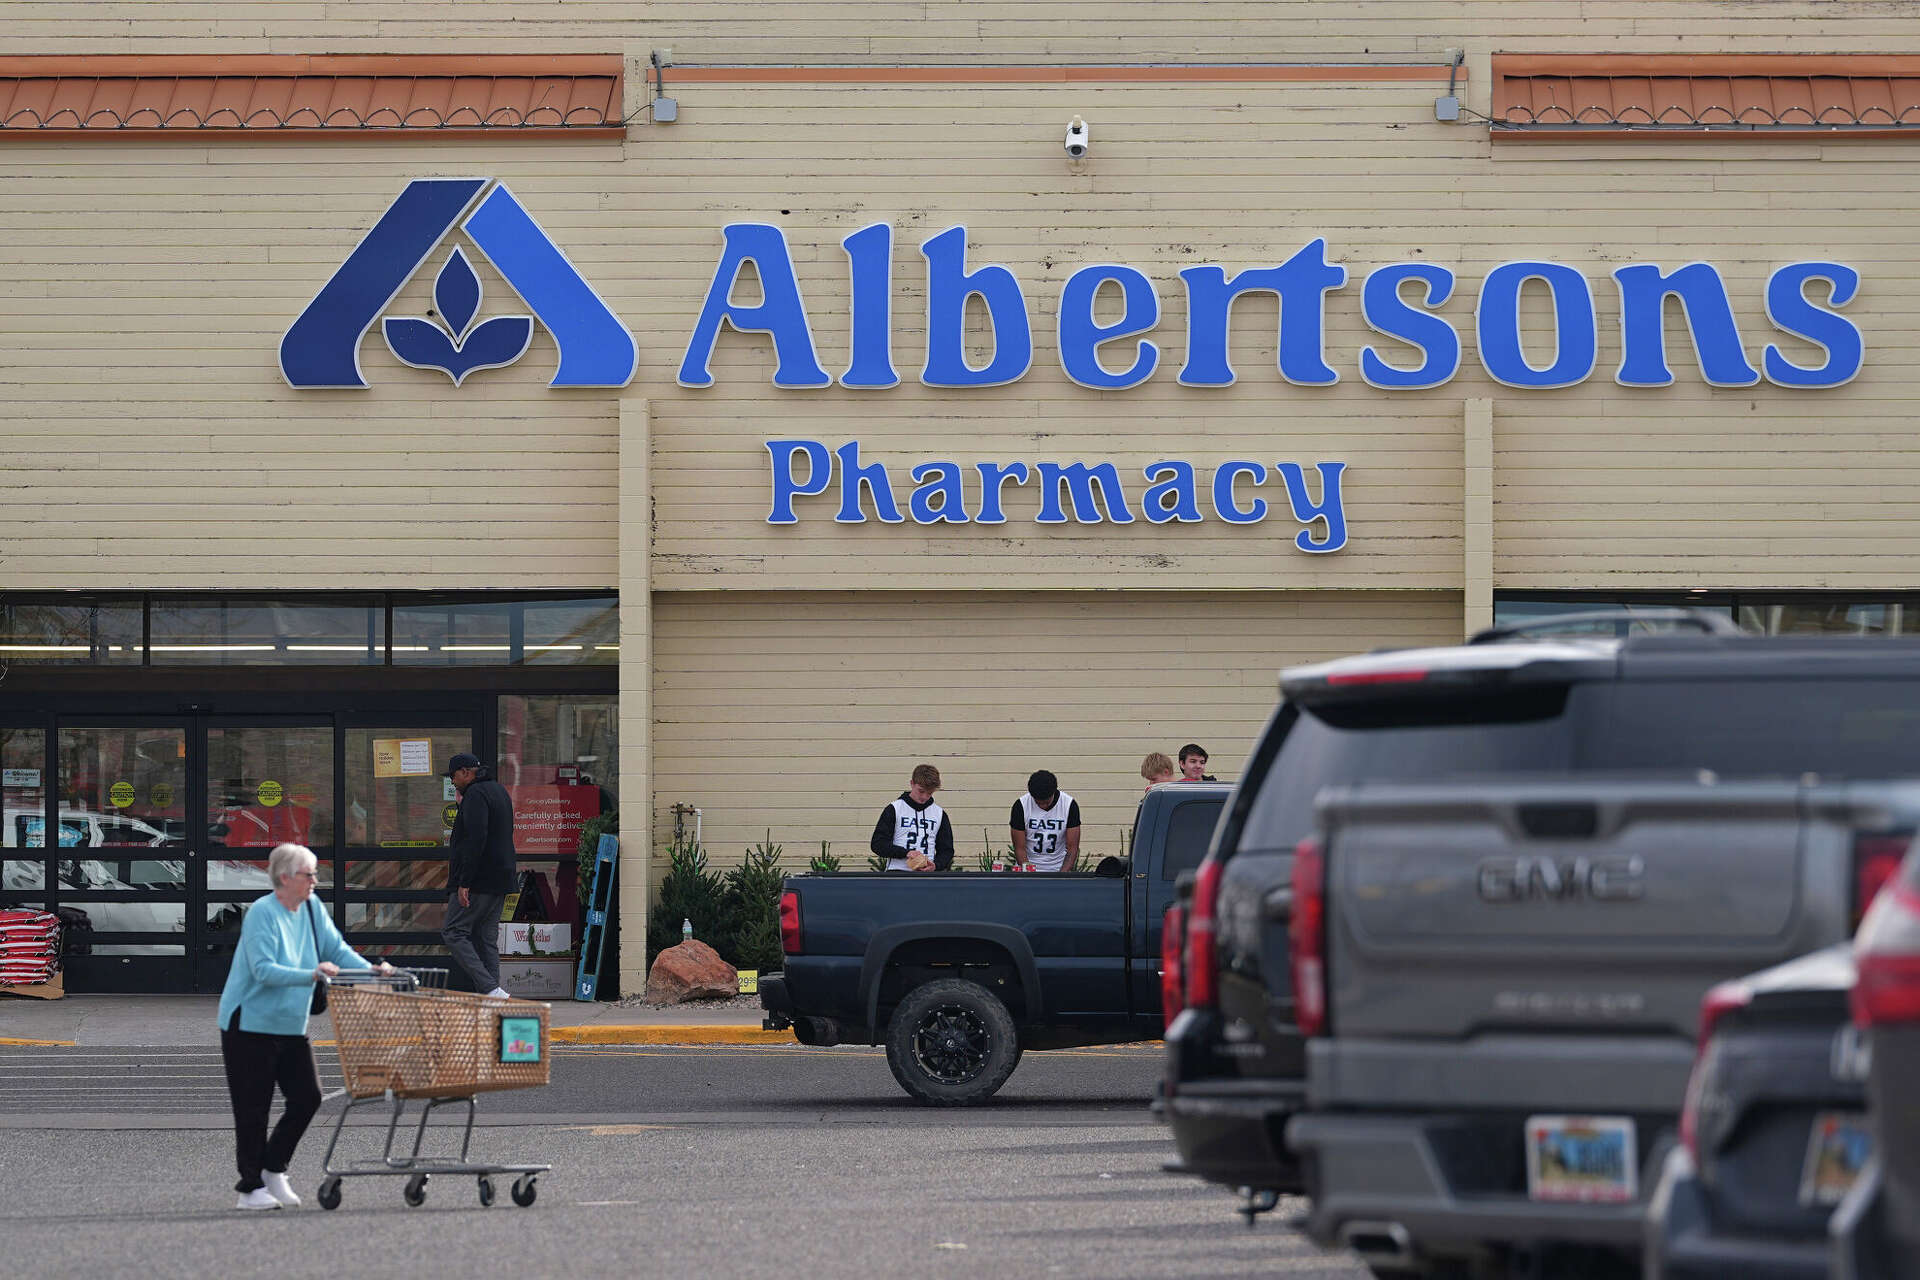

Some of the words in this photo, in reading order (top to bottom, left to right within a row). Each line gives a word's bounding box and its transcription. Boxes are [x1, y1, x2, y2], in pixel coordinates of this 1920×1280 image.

[677, 221, 1864, 389] Albertsons
[764, 437, 1349, 554] Pharmacy
[513, 822, 555, 831] nveniently
[514, 811, 552, 820] Carefully
[901, 817, 937, 830] EAST
[1028, 818, 1065, 831] EAST
[906, 832, 929, 854] 24
[1033, 832, 1058, 854] 33
[1478, 853, 1646, 903] GMC
